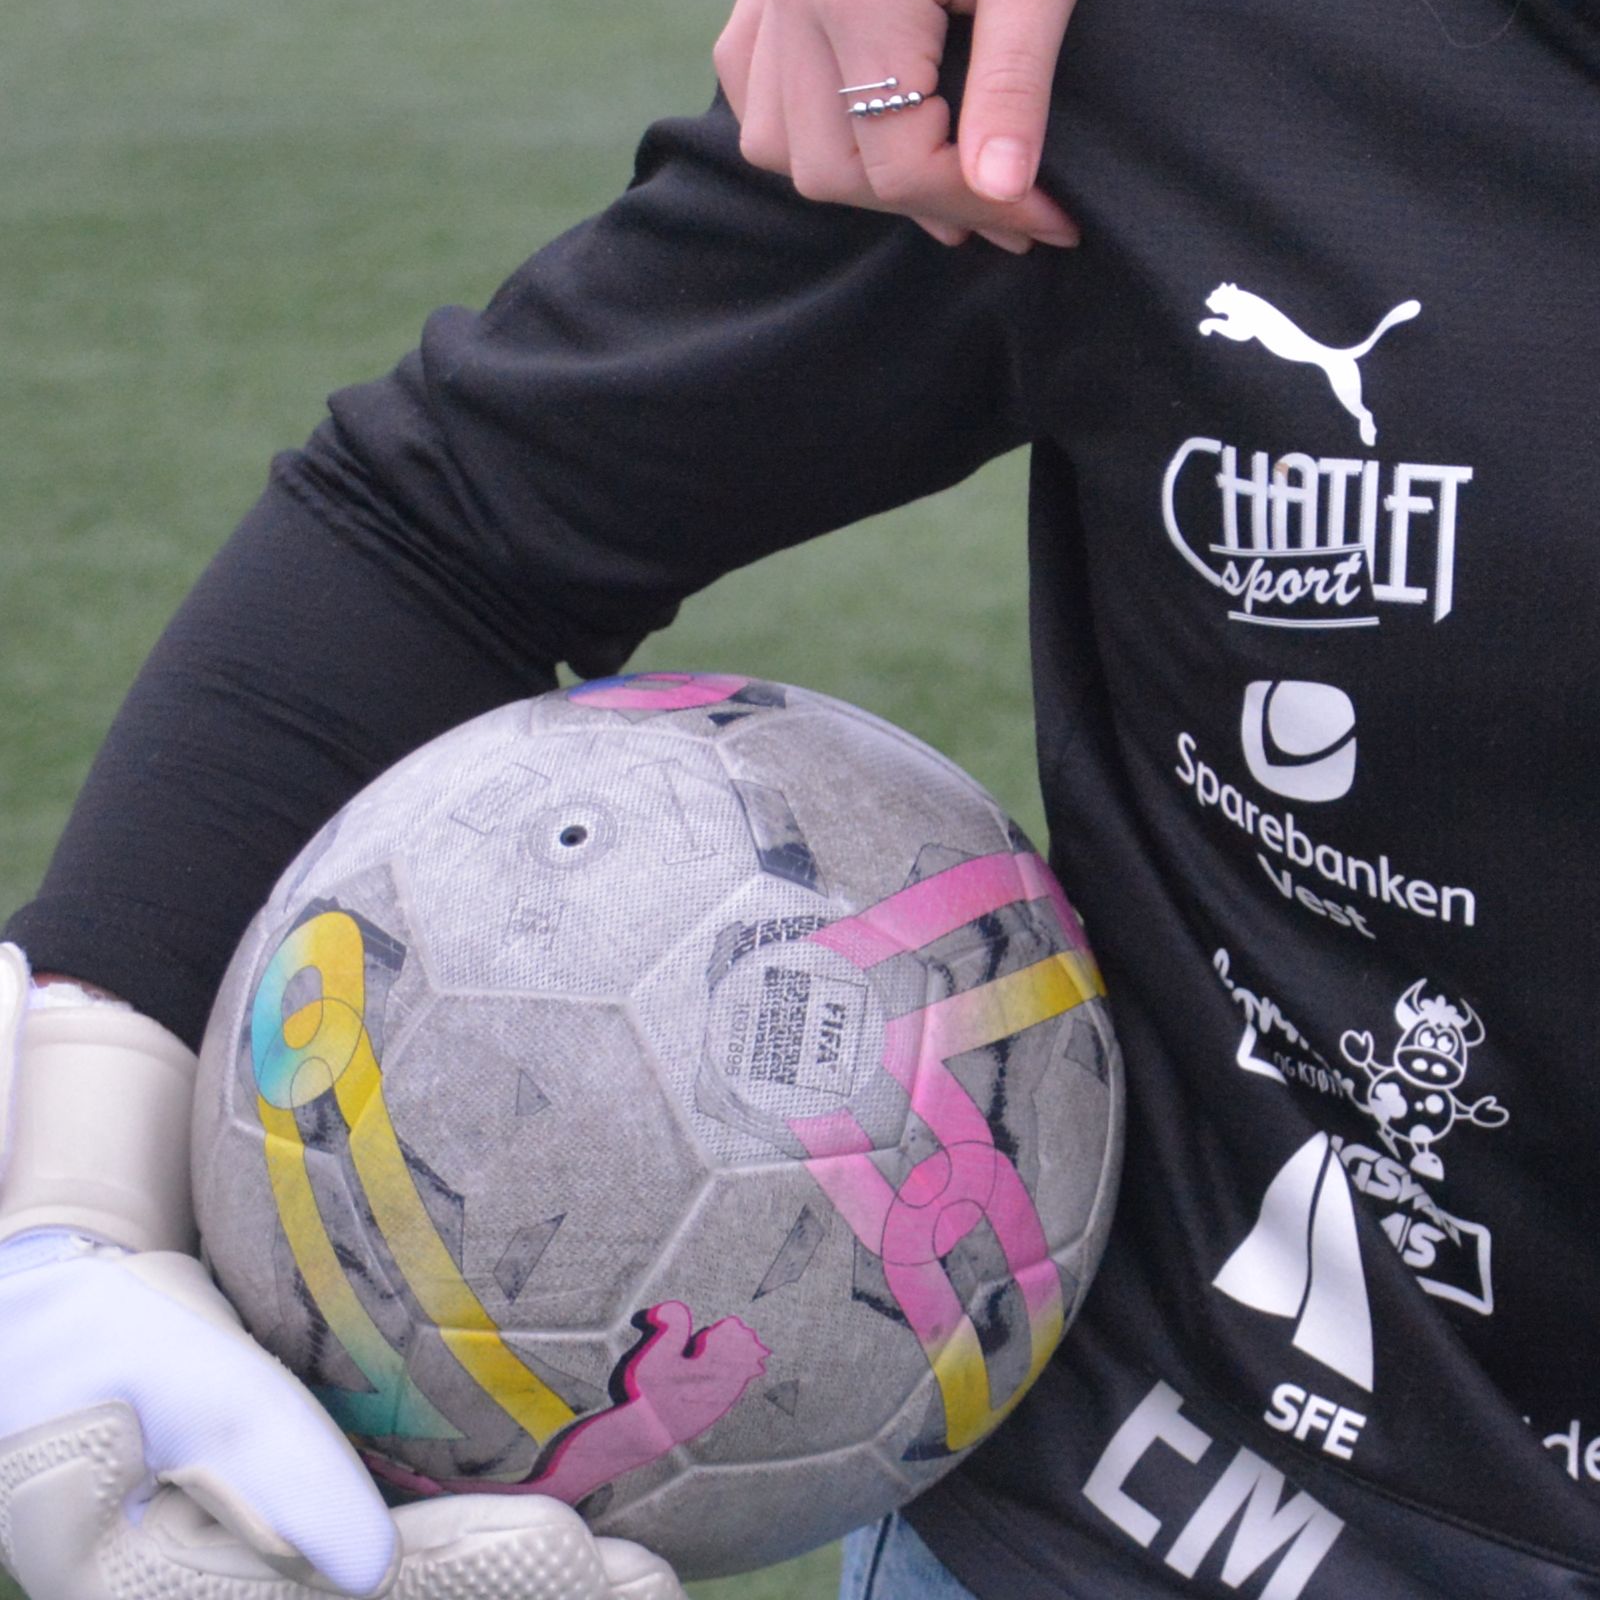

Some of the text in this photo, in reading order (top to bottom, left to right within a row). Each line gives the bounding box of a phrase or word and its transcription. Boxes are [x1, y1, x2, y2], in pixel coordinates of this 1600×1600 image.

[1220, 553, 1362, 614] sport
[1175, 733, 1475, 926] Sparebanken
[1257, 854, 1376, 939] Vest
[817, 1003, 846, 1064] FIFA
[1263, 1382, 1367, 1460] SFE
